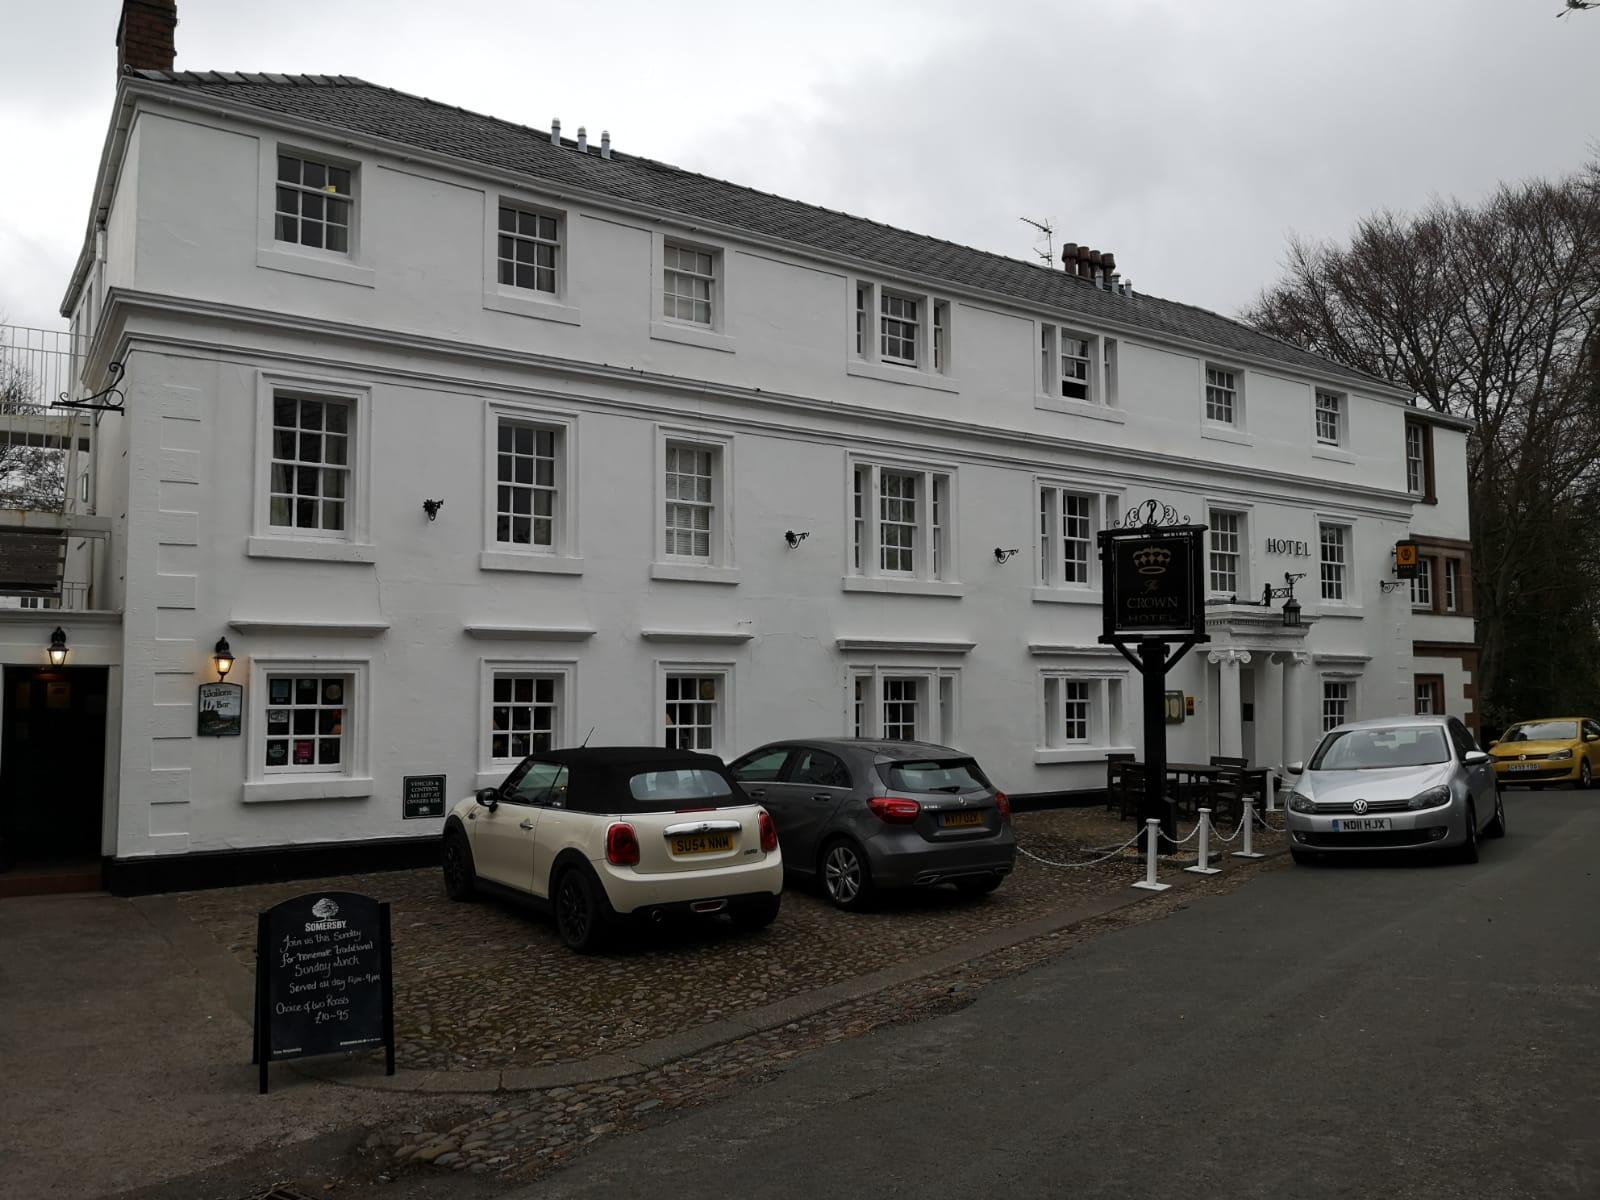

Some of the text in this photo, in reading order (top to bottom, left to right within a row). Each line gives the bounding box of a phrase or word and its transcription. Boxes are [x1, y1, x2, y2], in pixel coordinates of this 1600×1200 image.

[1267, 537, 1311, 557] HOTEL
[1126, 596, 1178, 609] CROWN
[1128, 614, 1177, 625] HOTEL
[216, 700, 231, 709] Bar
[1343, 819, 1385, 830] ND11 HJX
[677, 839, 706, 852] SU54
[305, 920, 347, 932] SOMERSBY
[279, 934, 303, 953] Join
[315, 933, 331, 943] this
[333, 929, 362, 942] Sunday
[294, 962, 331, 978] Sunday
[289, 980, 317, 994] Served
[319, 980, 330, 989] all
[331, 978, 346, 991] day
[303, 1000, 311, 1014] of
[312, 1001, 326, 1010] two
